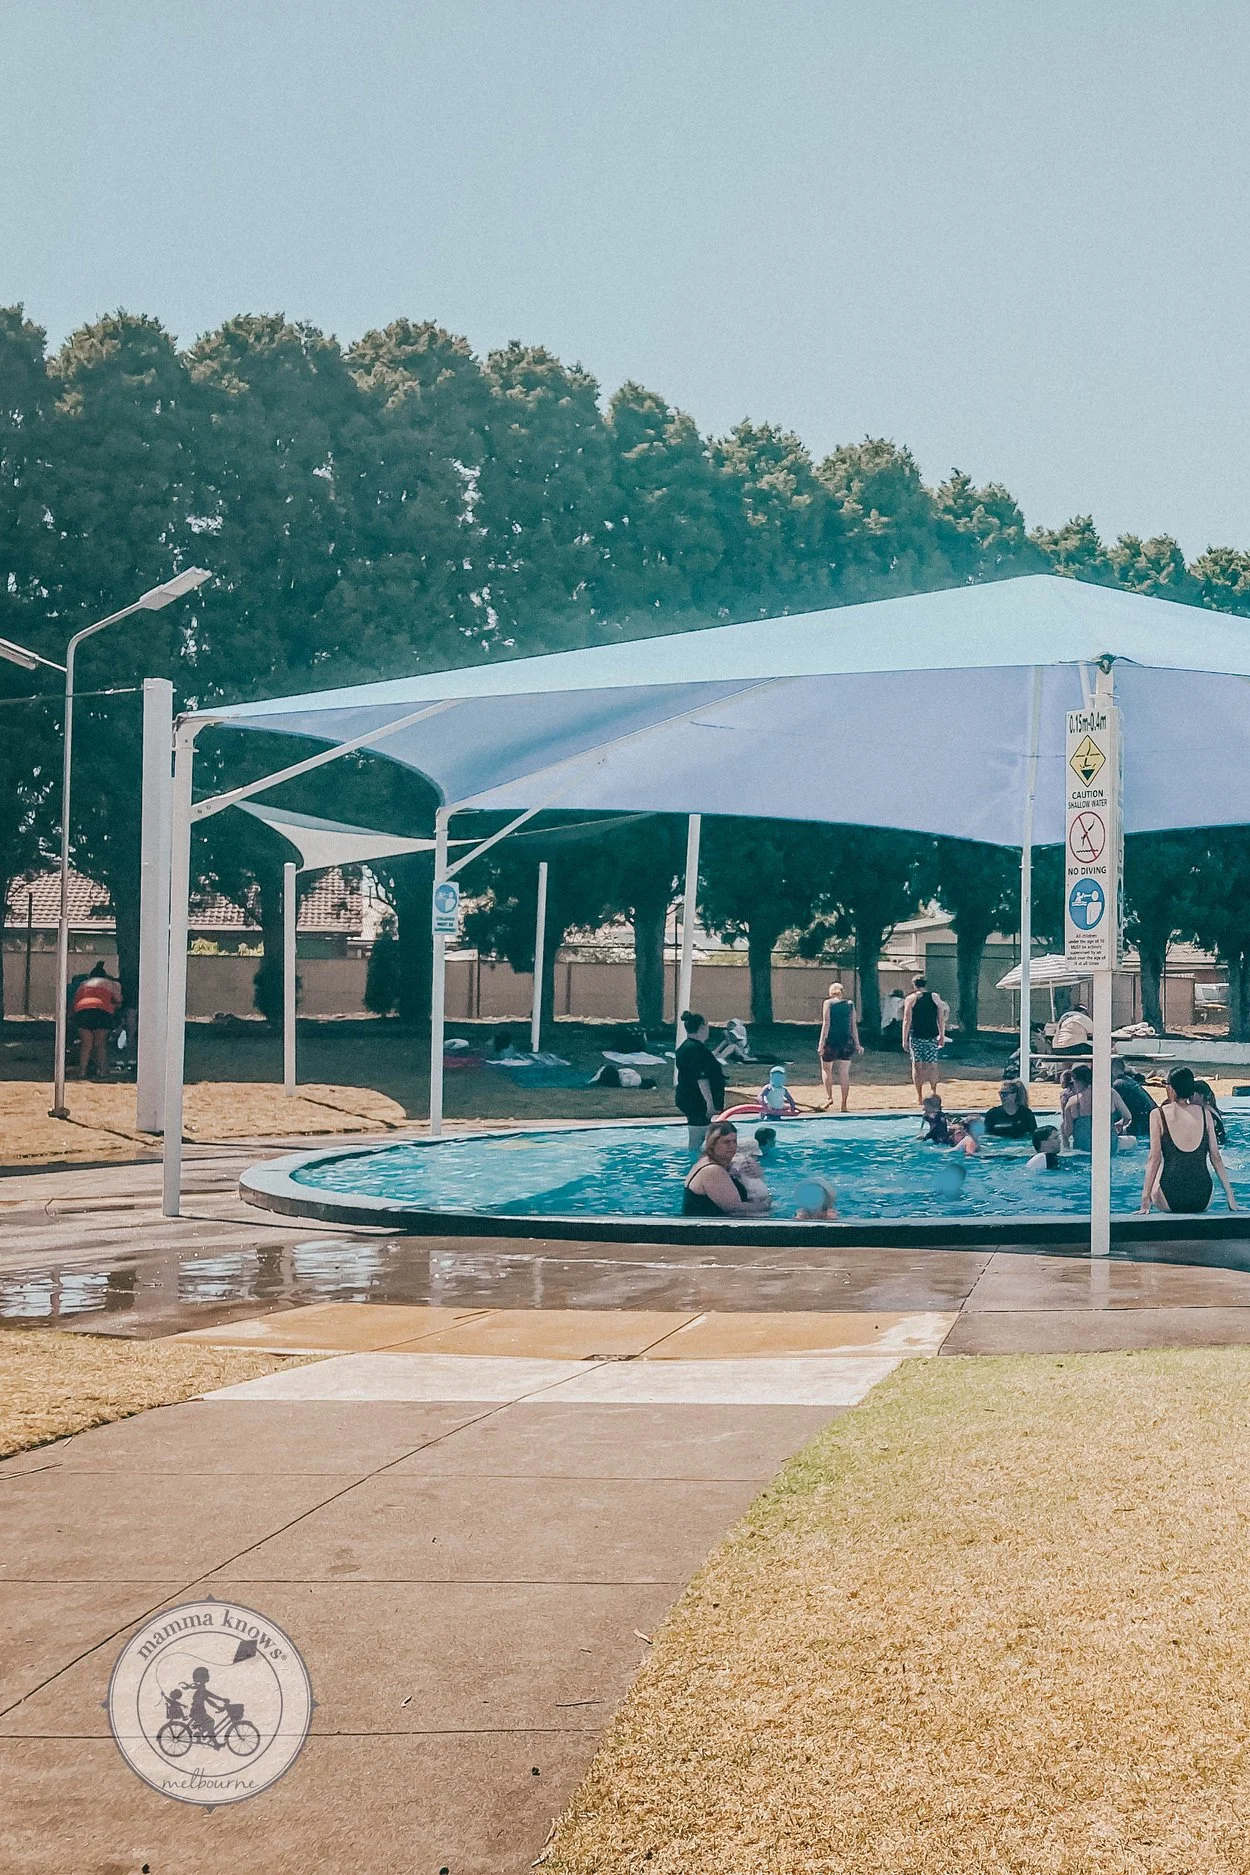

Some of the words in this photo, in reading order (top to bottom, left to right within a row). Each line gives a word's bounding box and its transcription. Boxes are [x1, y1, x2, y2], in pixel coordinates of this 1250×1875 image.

[1069, 711, 1107, 734] 0.15m-0.4m
[1072, 789, 1104, 799] CAUTION
[1068, 801, 1090, 810] SHALLOW
[1091, 799, 1107, 808] WATER
[1068, 867, 1079, 876] NO
[1081, 866, 1107, 875] DIVING
